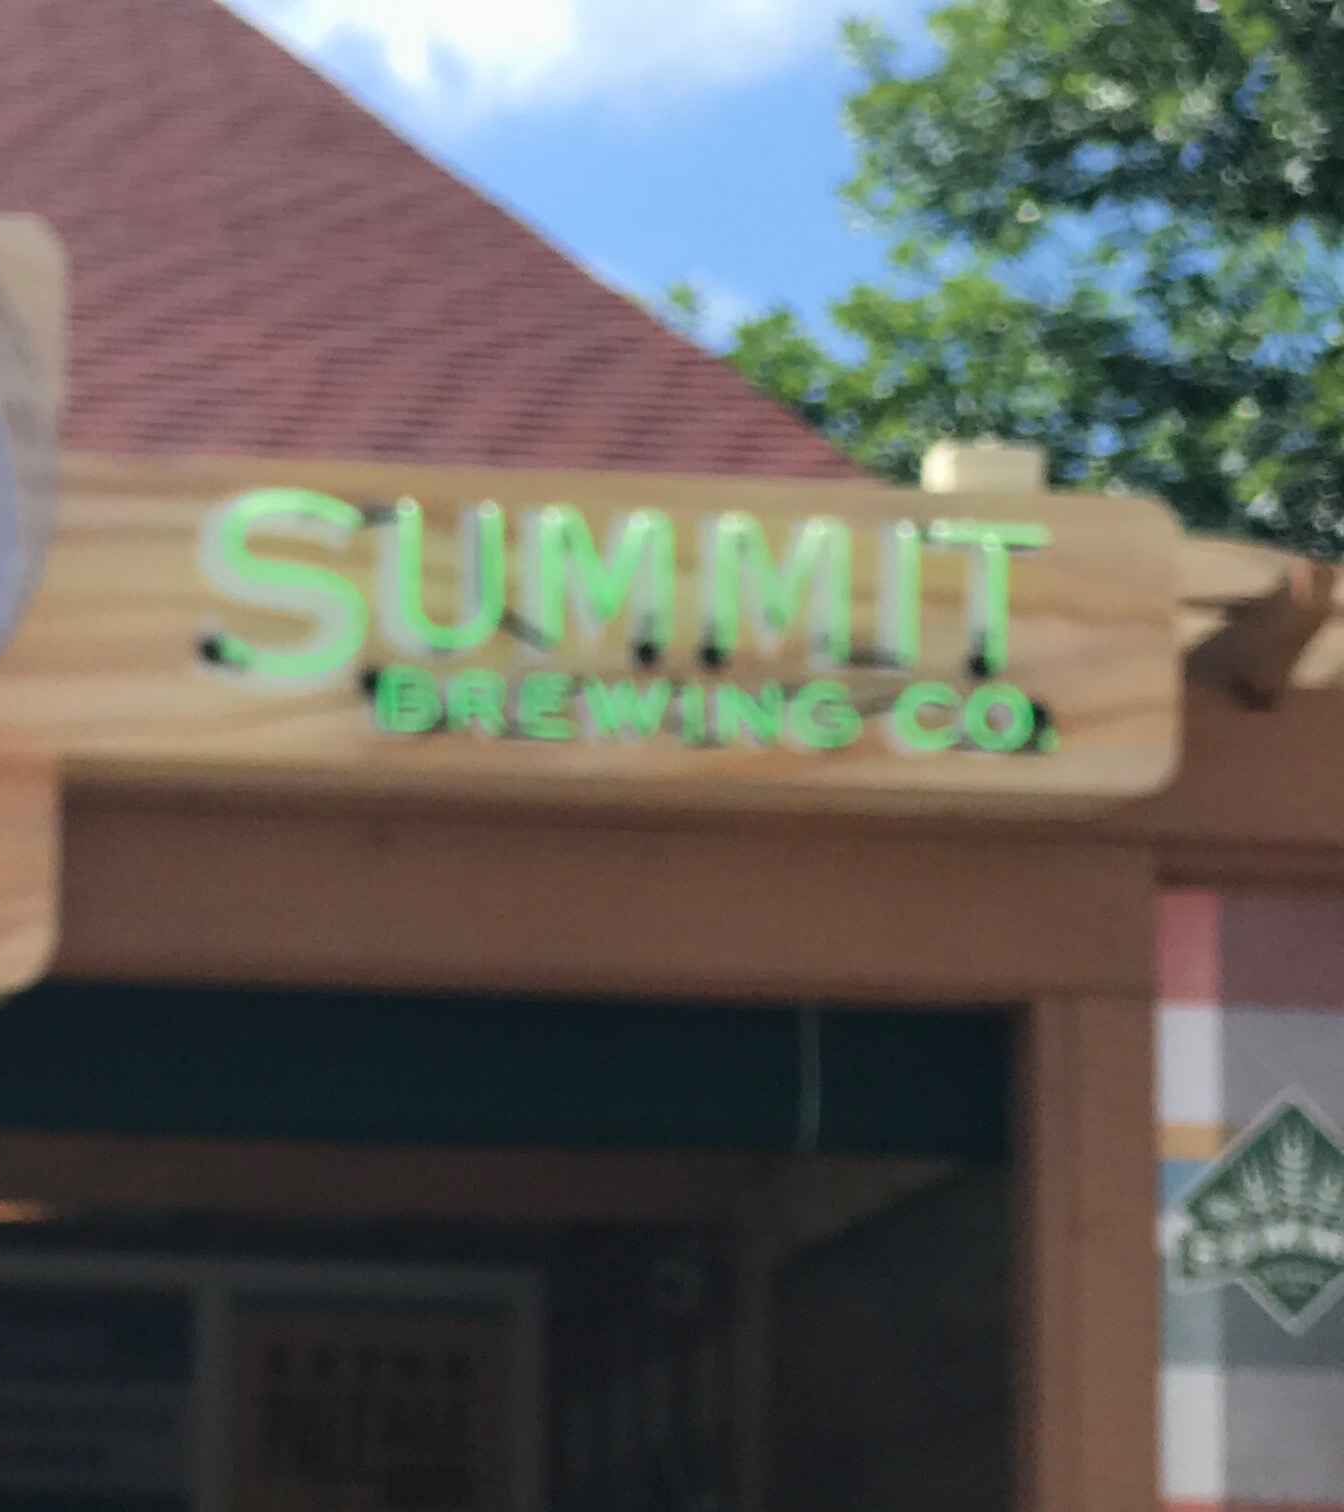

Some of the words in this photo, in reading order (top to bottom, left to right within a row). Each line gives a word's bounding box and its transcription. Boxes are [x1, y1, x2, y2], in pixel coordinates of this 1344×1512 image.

[196, 484, 1052, 680] SUMMIT
[376, 662, 864, 750] BREWING
[888, 678, 1060, 754] CO.
